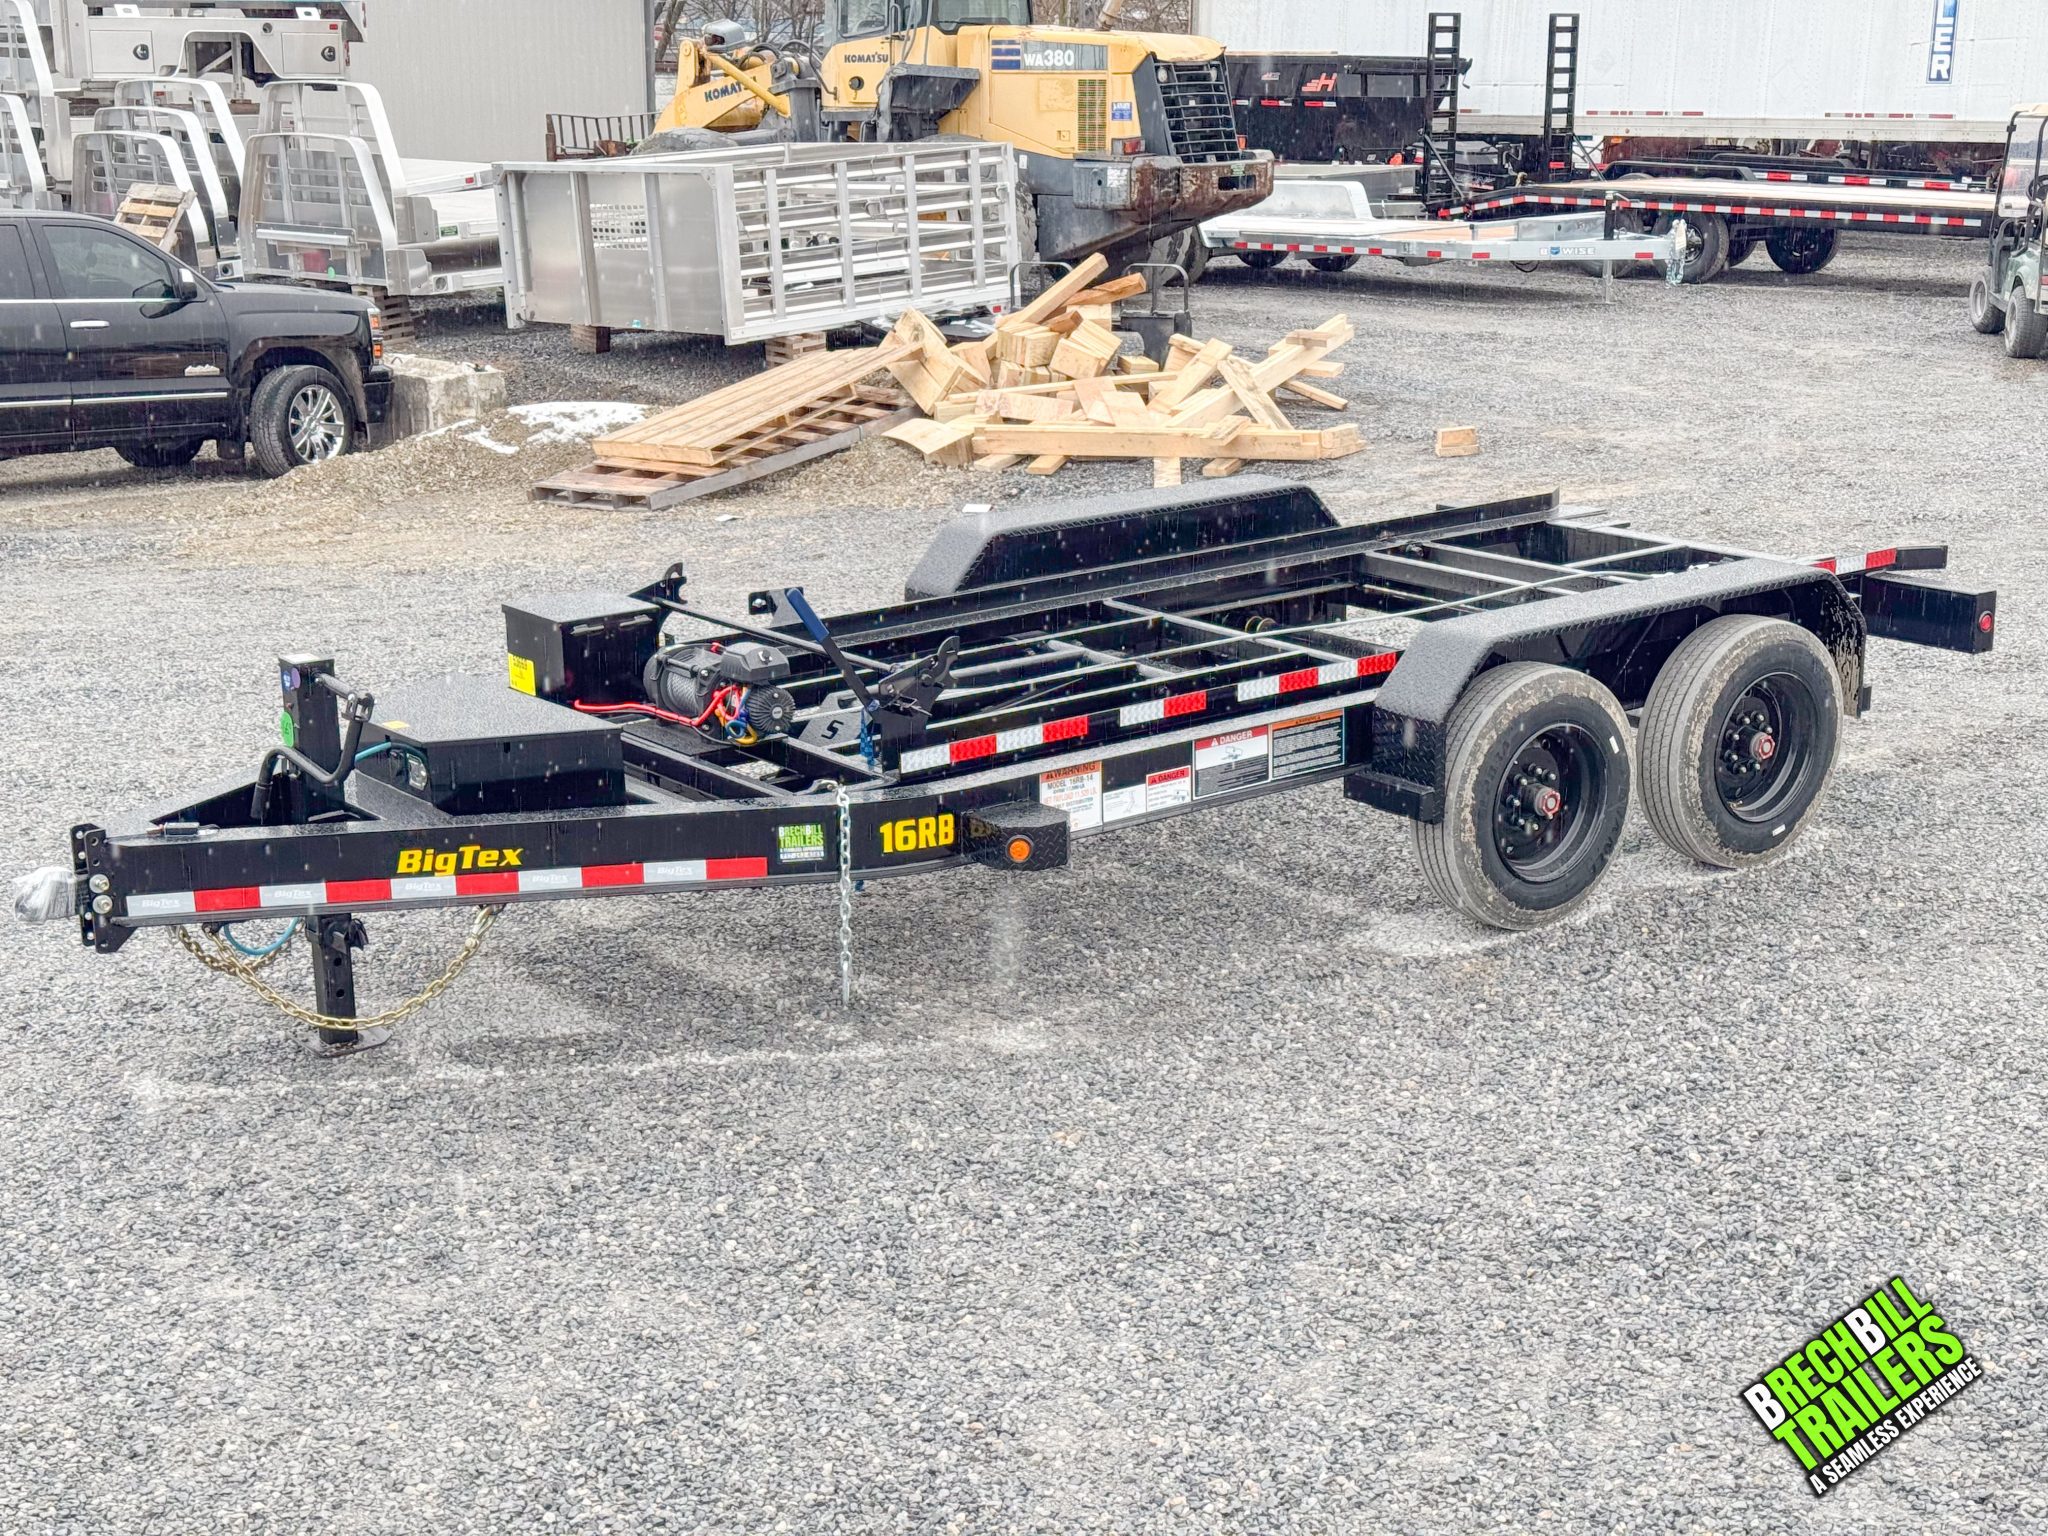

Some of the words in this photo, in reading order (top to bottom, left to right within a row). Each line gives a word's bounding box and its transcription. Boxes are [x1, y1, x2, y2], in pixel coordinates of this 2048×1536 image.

[844, 52, 889, 63] KOMATSU
[1023, 50, 1075, 67] WA380
[704, 75, 757, 103] KOMAT
[1219, 730, 1253, 745] DANGER
[1158, 769, 1185, 783] DANGER
[778, 824, 823, 837] BRECHBILL
[879, 813, 954, 854] 16RB
[779, 834, 824, 849] TRAILERS
[396, 845, 524, 877] BigTex
[657, 866, 693, 876] BigTex
[532, 873, 569, 884] BigTex
[404, 880, 443, 892] BigTex
[273, 888, 313, 900] BigTex
[142, 898, 181, 908] BigTex
